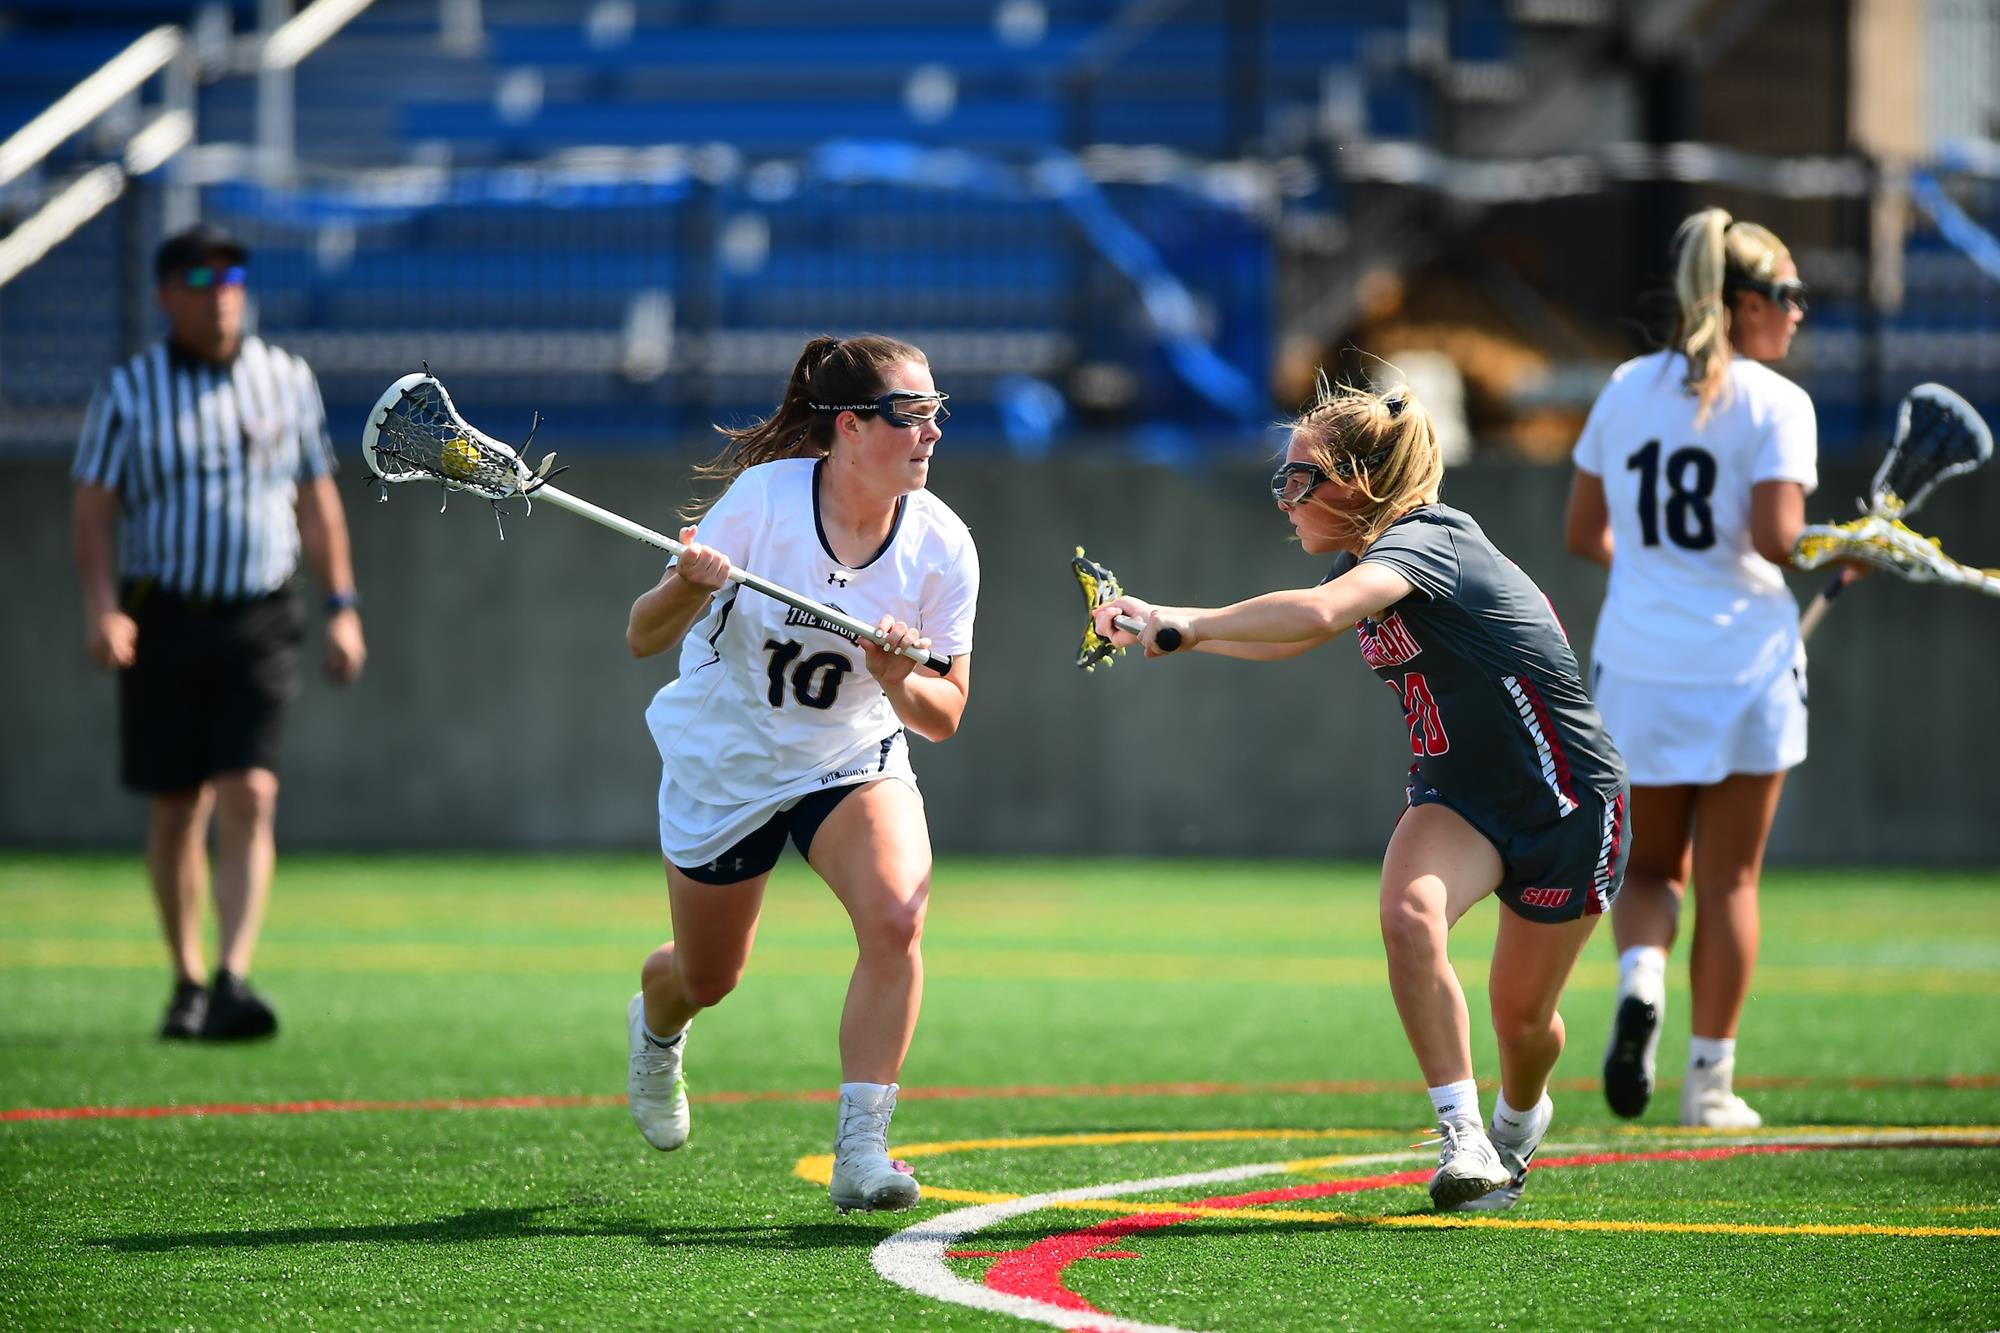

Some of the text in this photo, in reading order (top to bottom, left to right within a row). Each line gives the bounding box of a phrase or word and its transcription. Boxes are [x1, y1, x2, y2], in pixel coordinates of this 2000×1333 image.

[1627, 438, 1717, 551] 18
[789, 607, 857, 640] THE MOUN
[763, 638, 855, 710] 10
[1520, 887, 1573, 908] SHU
